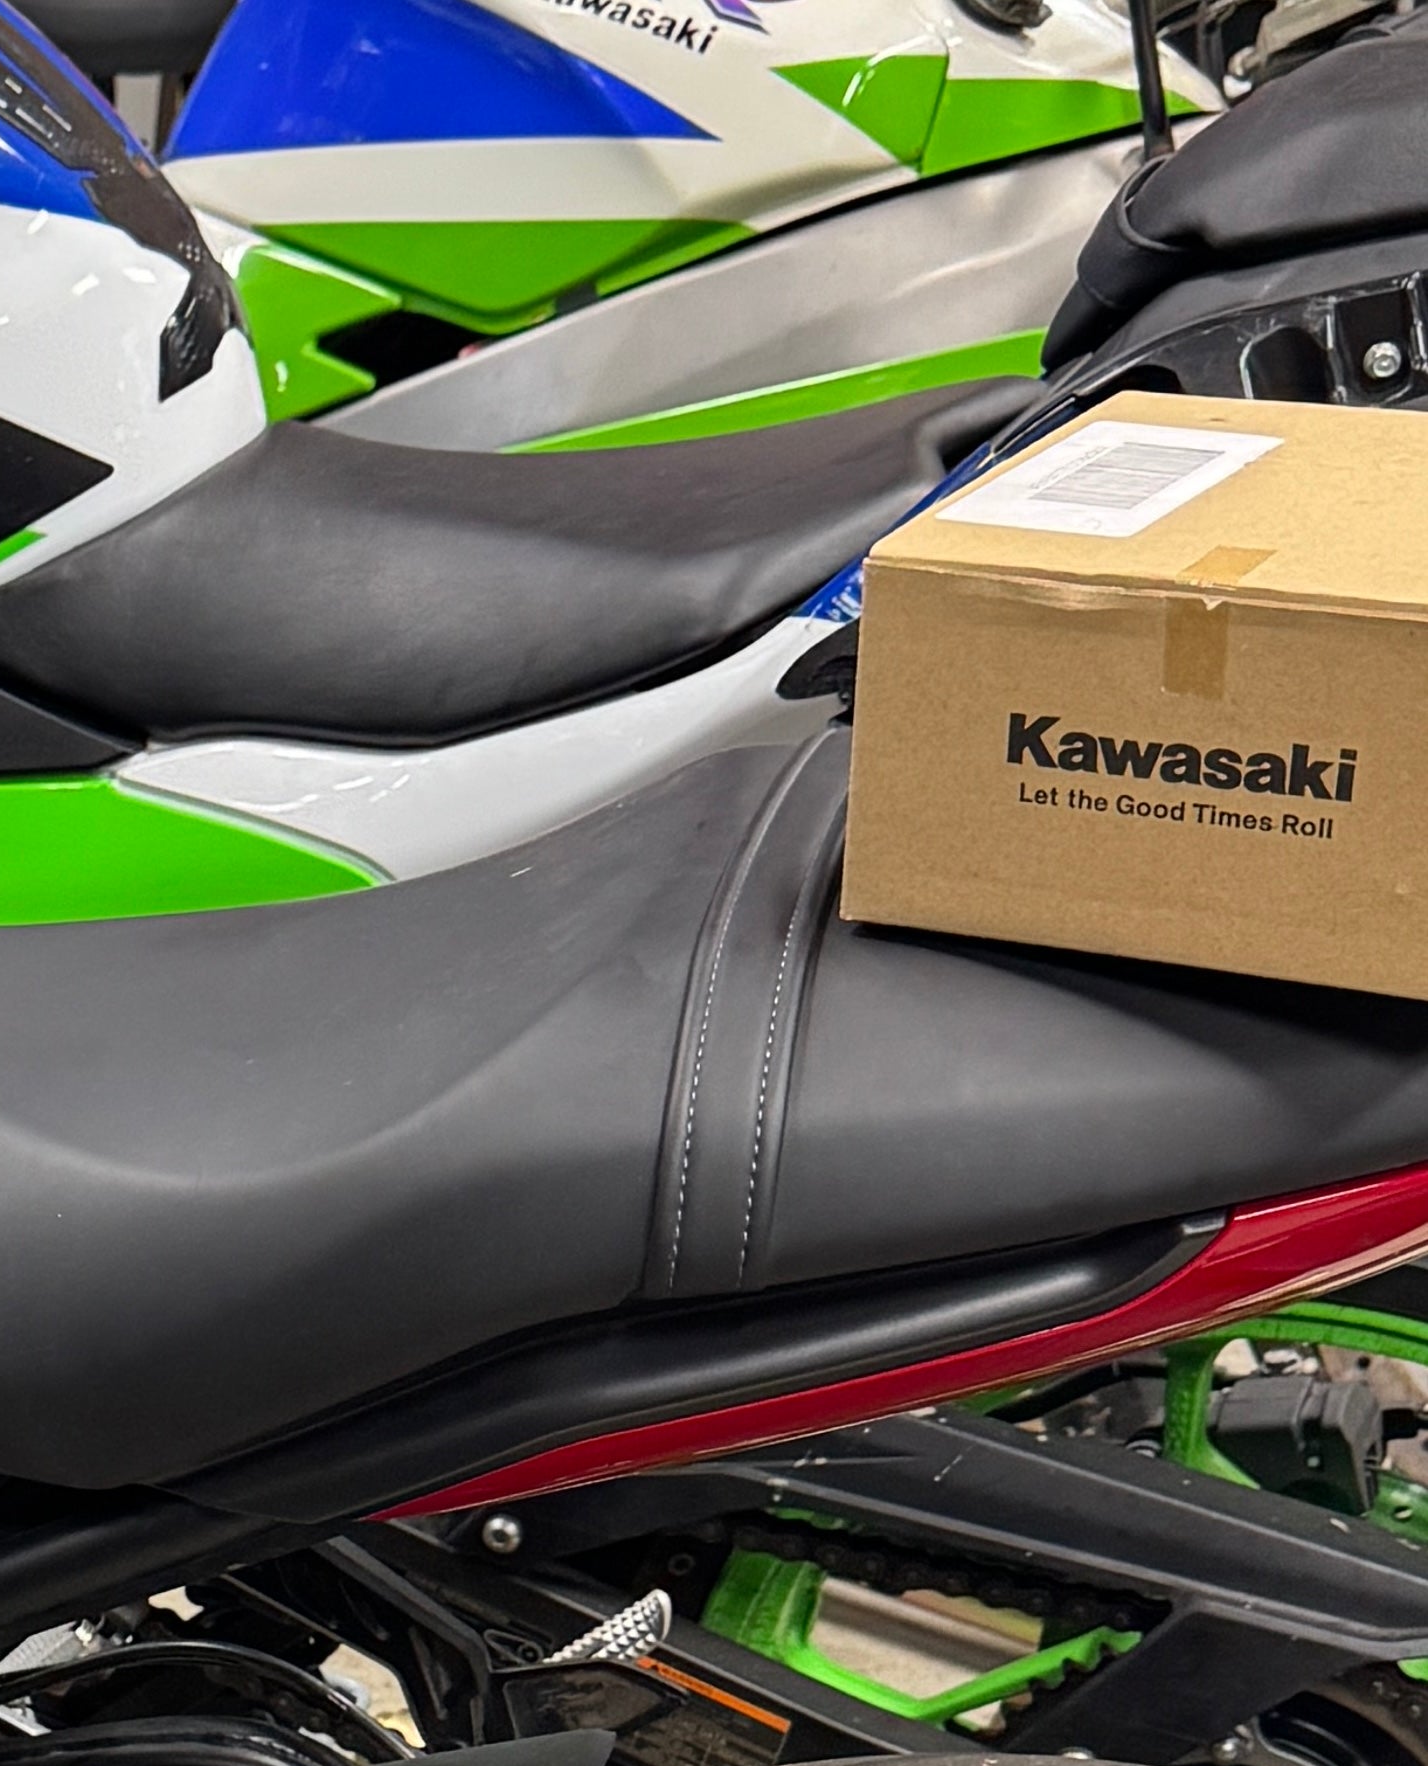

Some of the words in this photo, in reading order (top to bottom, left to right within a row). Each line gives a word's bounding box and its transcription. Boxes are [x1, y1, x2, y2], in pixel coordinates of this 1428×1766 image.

[554, 0, 719, 54] wasaki
[1006, 712, 1358, 803] Kawasaki
[1018, 783, 1058, 807] Let
[1067, 789, 1108, 812] the
[1116, 795, 1186, 823] Good
[1192, 803, 1274, 832] Times
[1281, 813, 1334, 840] Roll
